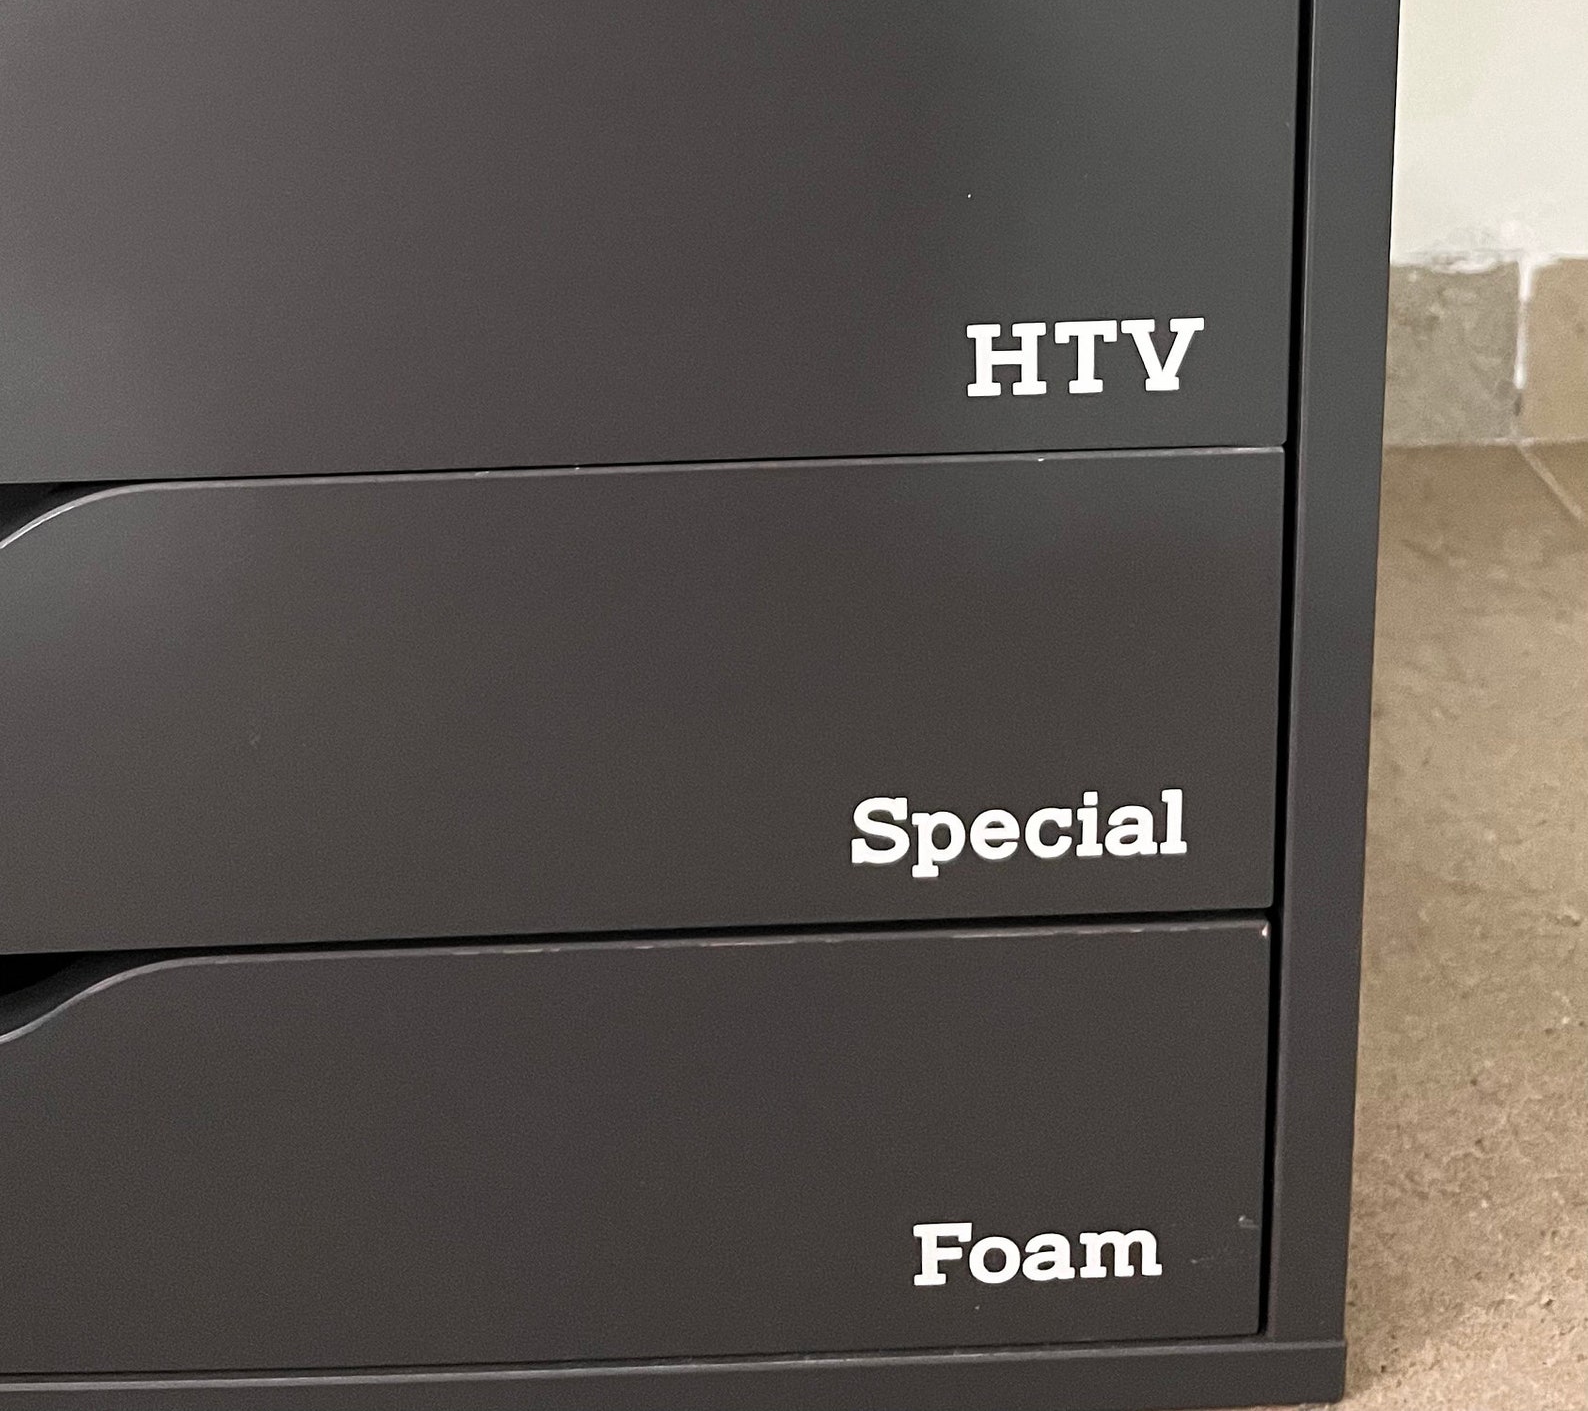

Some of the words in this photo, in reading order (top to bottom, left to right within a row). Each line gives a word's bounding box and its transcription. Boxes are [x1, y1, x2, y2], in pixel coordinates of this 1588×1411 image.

[966, 317, 1205, 397] HTV
[851, 789, 1188, 878] Special
[913, 1223, 1163, 1286] Foam
